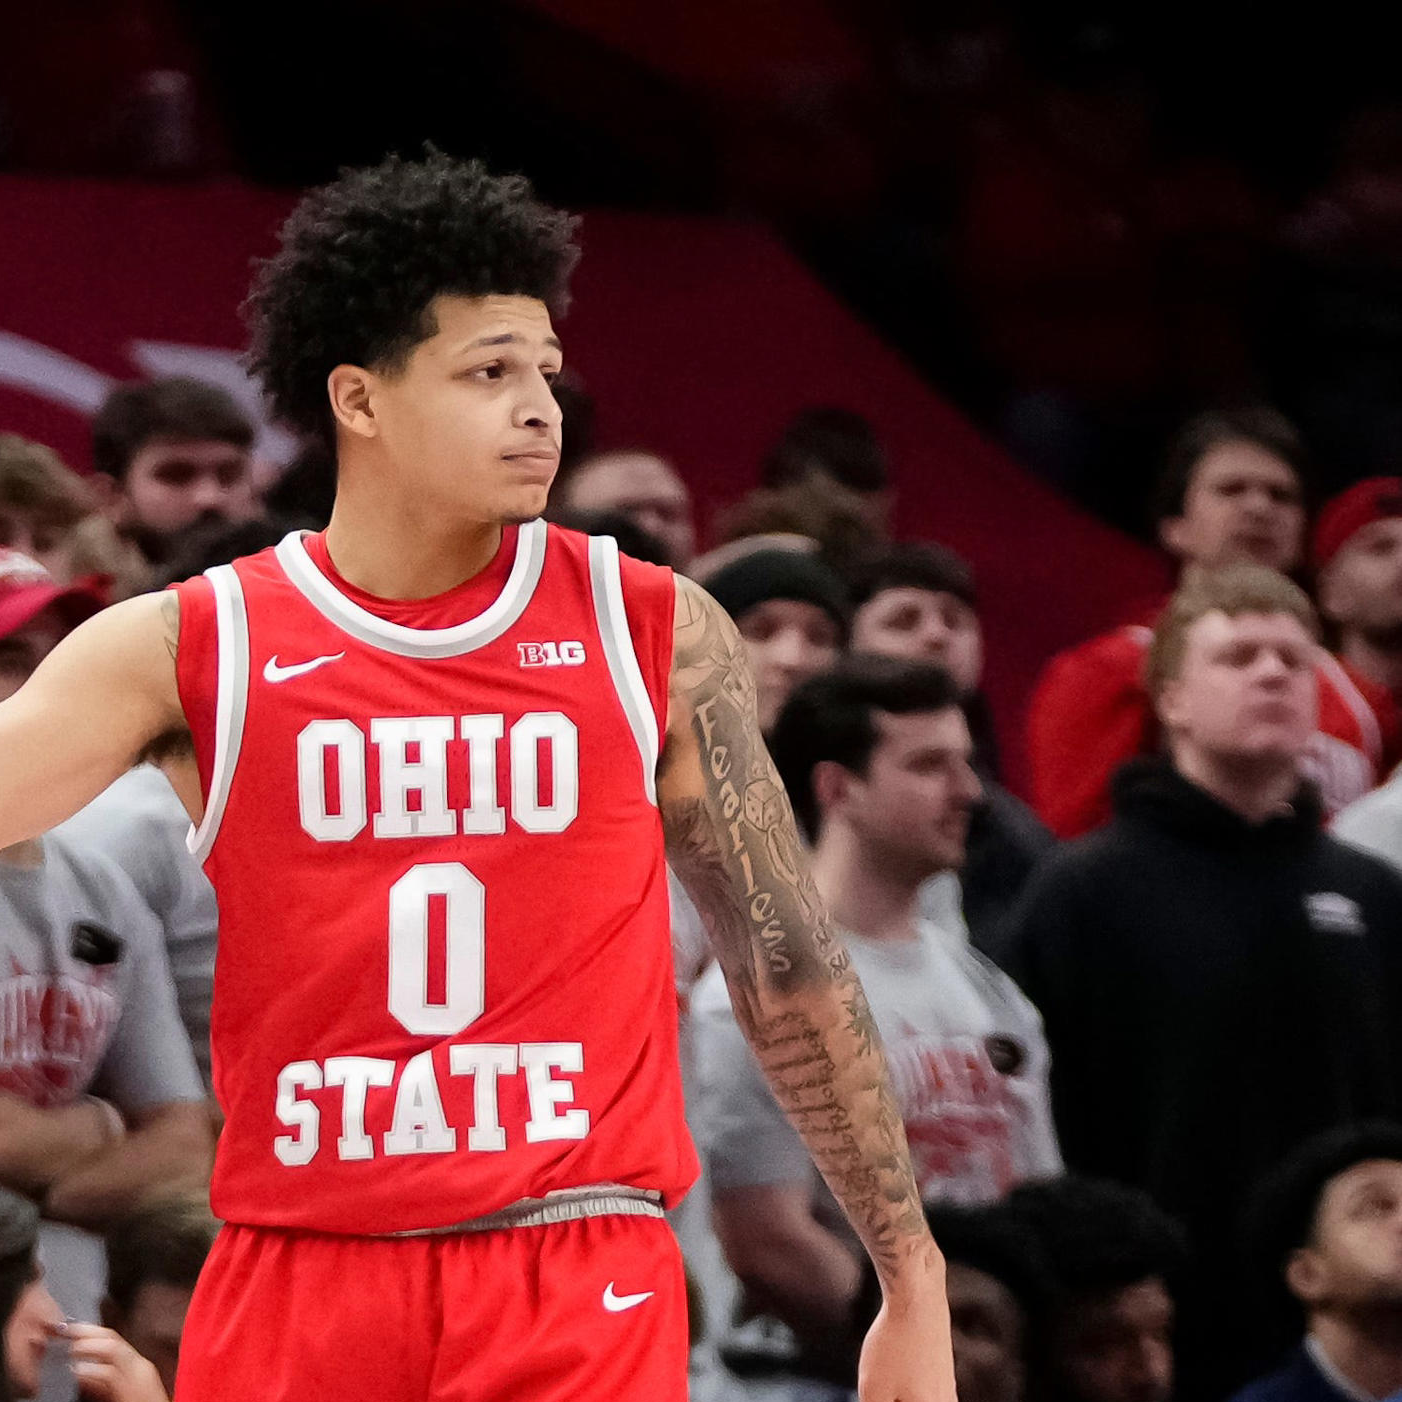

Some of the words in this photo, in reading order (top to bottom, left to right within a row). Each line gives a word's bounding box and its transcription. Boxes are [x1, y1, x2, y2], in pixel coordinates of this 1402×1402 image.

[297, 711, 579, 842] OHIO
[388, 862, 486, 1036] 0
[274, 1041, 591, 1166] STATE
